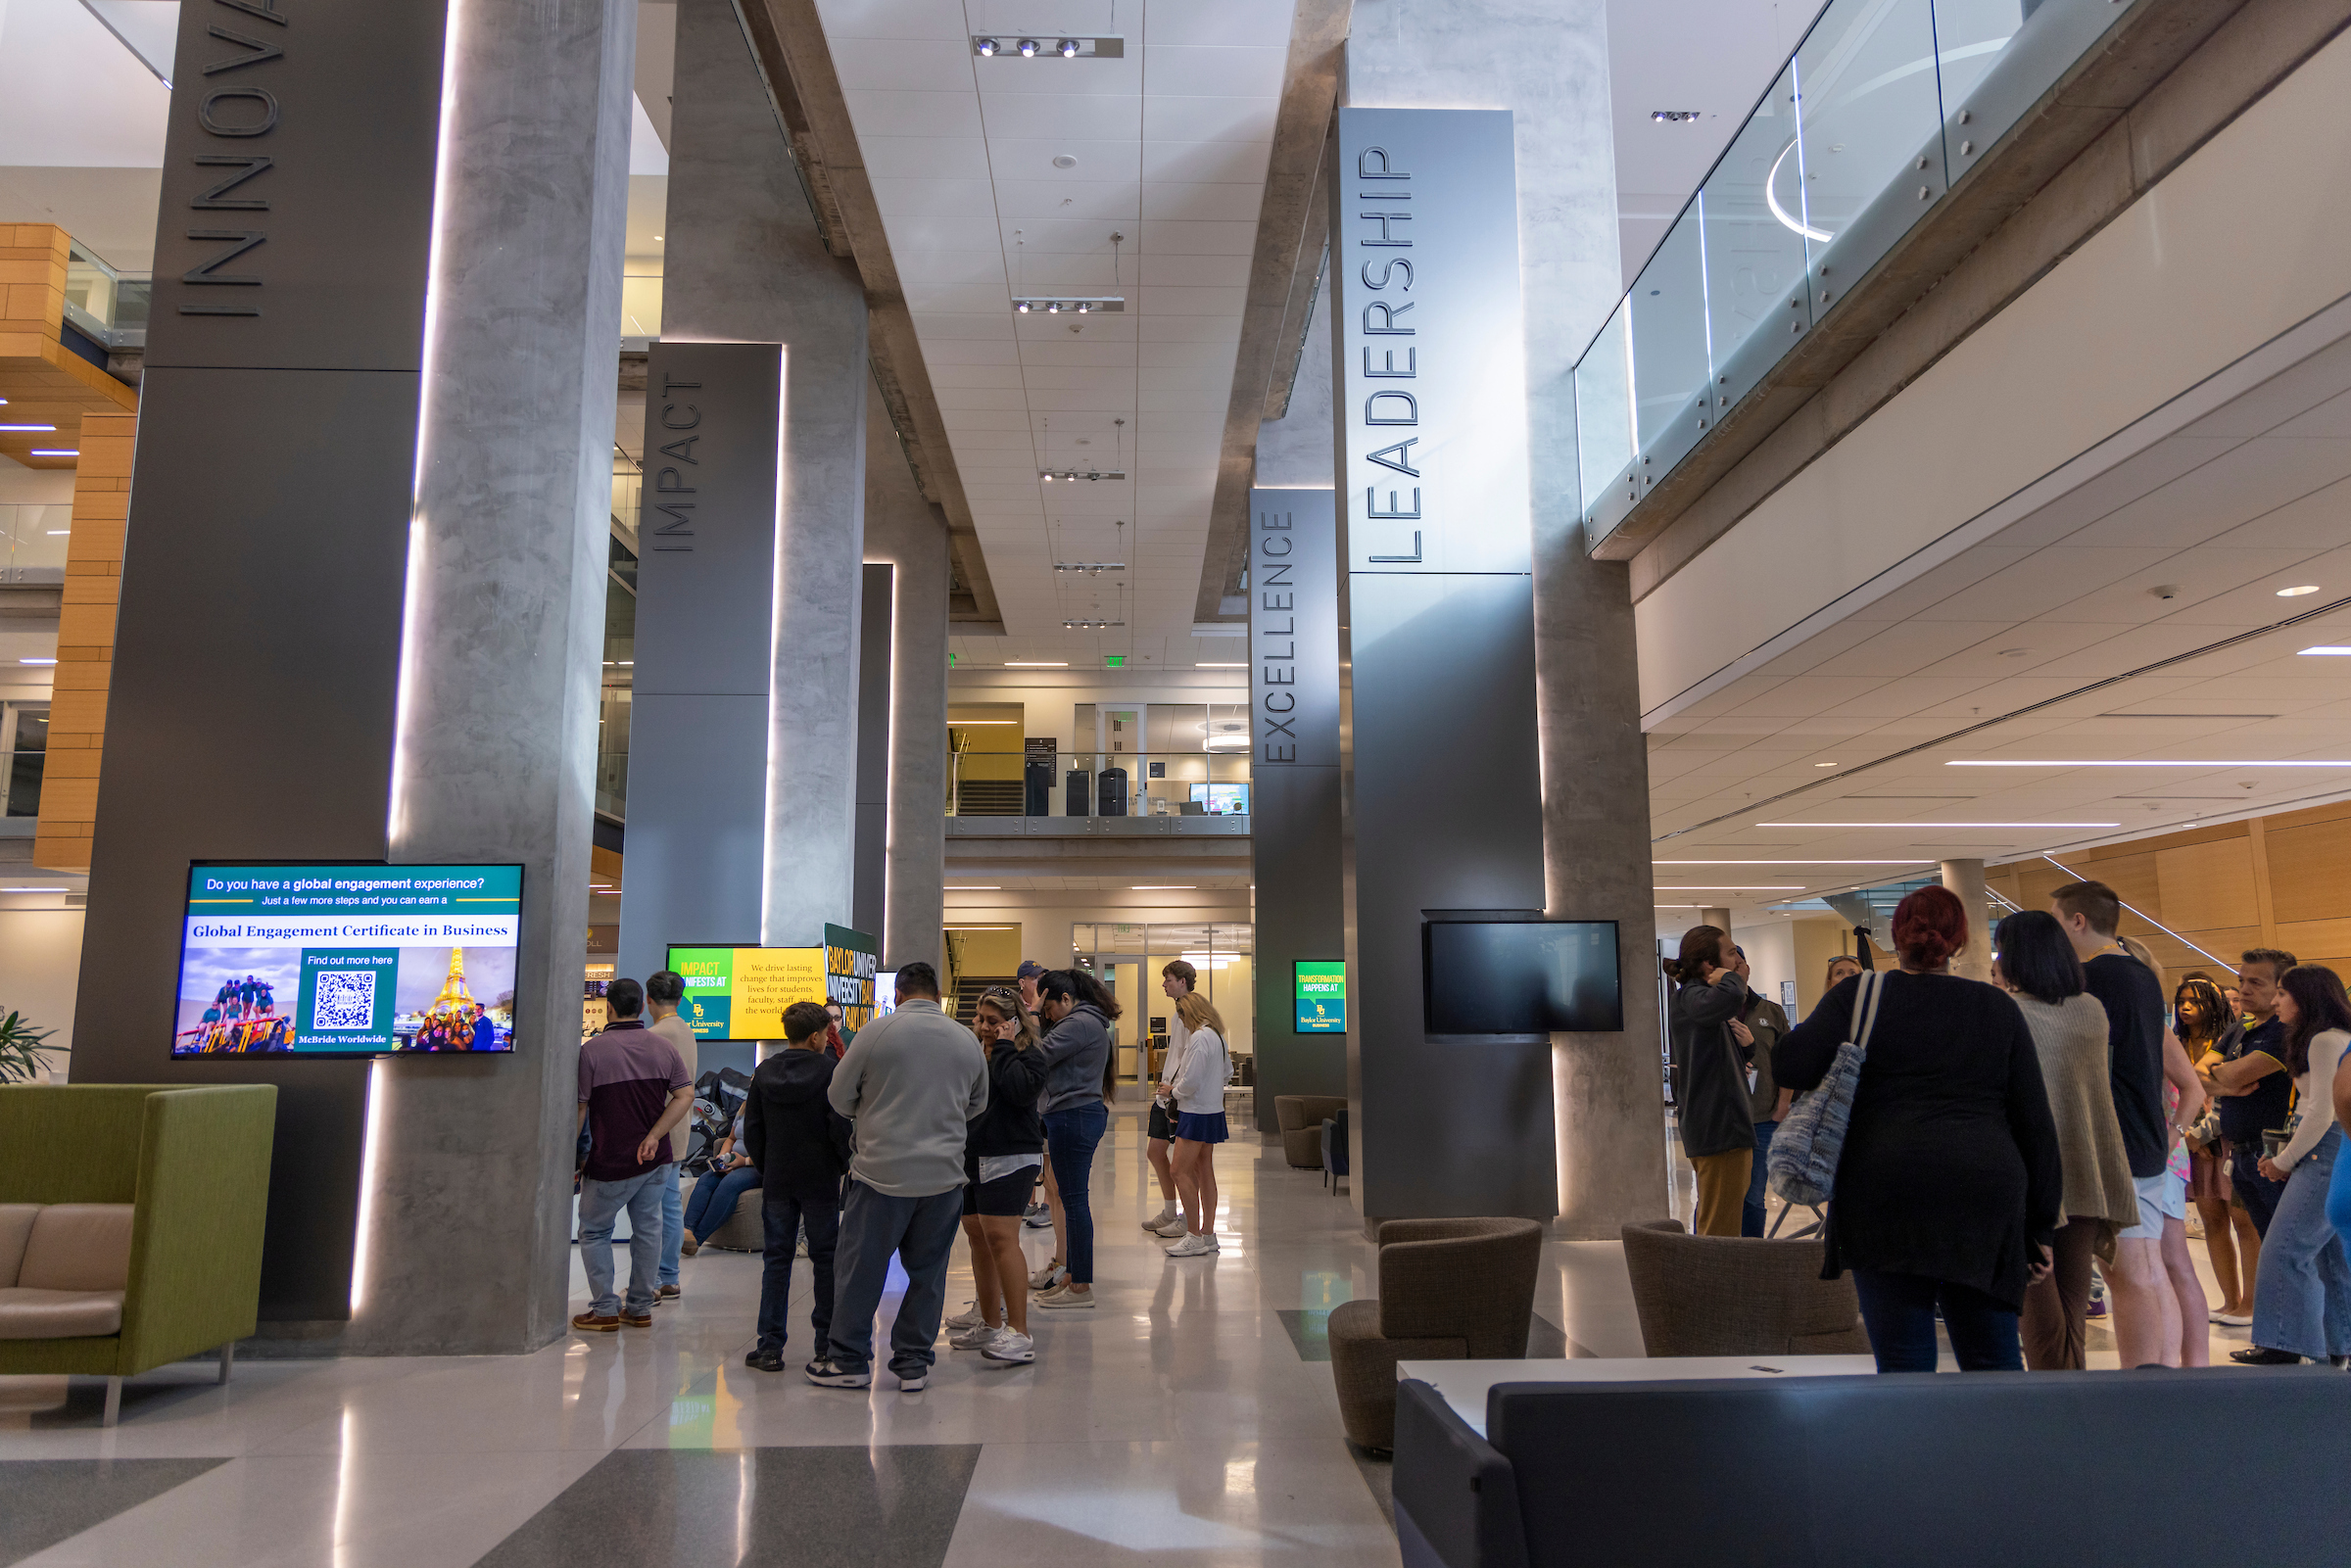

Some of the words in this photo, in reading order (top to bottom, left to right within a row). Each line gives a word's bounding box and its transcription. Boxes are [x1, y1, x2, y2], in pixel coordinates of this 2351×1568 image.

[1359, 144, 1423, 563] LEADERSHIP
[653, 371, 702, 551] IMPACT
[1261, 511, 1296, 763] EXCELLENCE
[1109, 656, 1124, 666] EXIT
[207, 879, 223, 890] Do
[226, 880, 248, 892] you
[251, 879, 279, 890] have
[283, 880, 290, 889] a
[294, 879, 332, 892] global
[335, 879, 411, 892] engagement
[413, 878, 485, 891] experience?
[262, 896, 281, 905] Just
[292, 896, 308, 905] few
[335, 896, 360, 906] steps
[381, 897, 398, 906] you
[193, 925, 242, 937] Global
[246, 926, 338, 939] Engagement
[342, 925, 419, 936] Certificate
[423, 925, 438, 936] in
[443, 924, 508, 936] Business
[308, 956, 328, 965] Find
[329, 956, 345, 965] out
[372, 956, 393, 965] here
[828, 945, 854, 976] BAYLOR
[681, 962, 720, 975] IMPACT
[787, 964, 813, 973] lasting
[716, 976, 727, 986] AT
[740, 975, 767, 983] change
[787, 974, 823, 983] improves
[747, 996, 775, 1005] faculty,
[777, 995, 796, 1004] staff,
[692, 1020, 725, 1029] University
[298, 1035, 336, 1044] McBride
[337, 1034, 386, 1044] Worldwide
